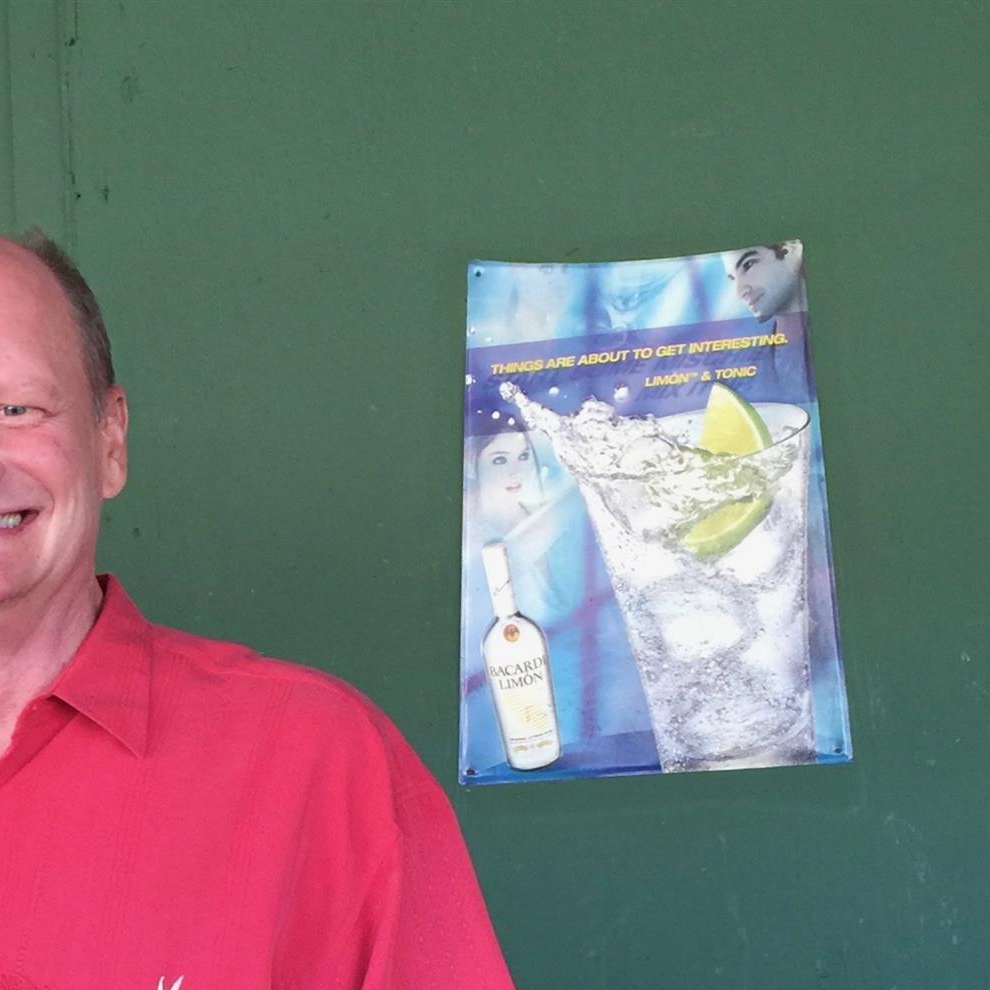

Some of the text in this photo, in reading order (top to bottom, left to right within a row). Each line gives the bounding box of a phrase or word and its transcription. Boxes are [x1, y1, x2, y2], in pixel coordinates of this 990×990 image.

[491, 333, 788, 375] THINGS ARE ABOUT TO GET INTERESTING.
[701, 369, 711, 381] &
[715, 366, 757, 379] TONIC
